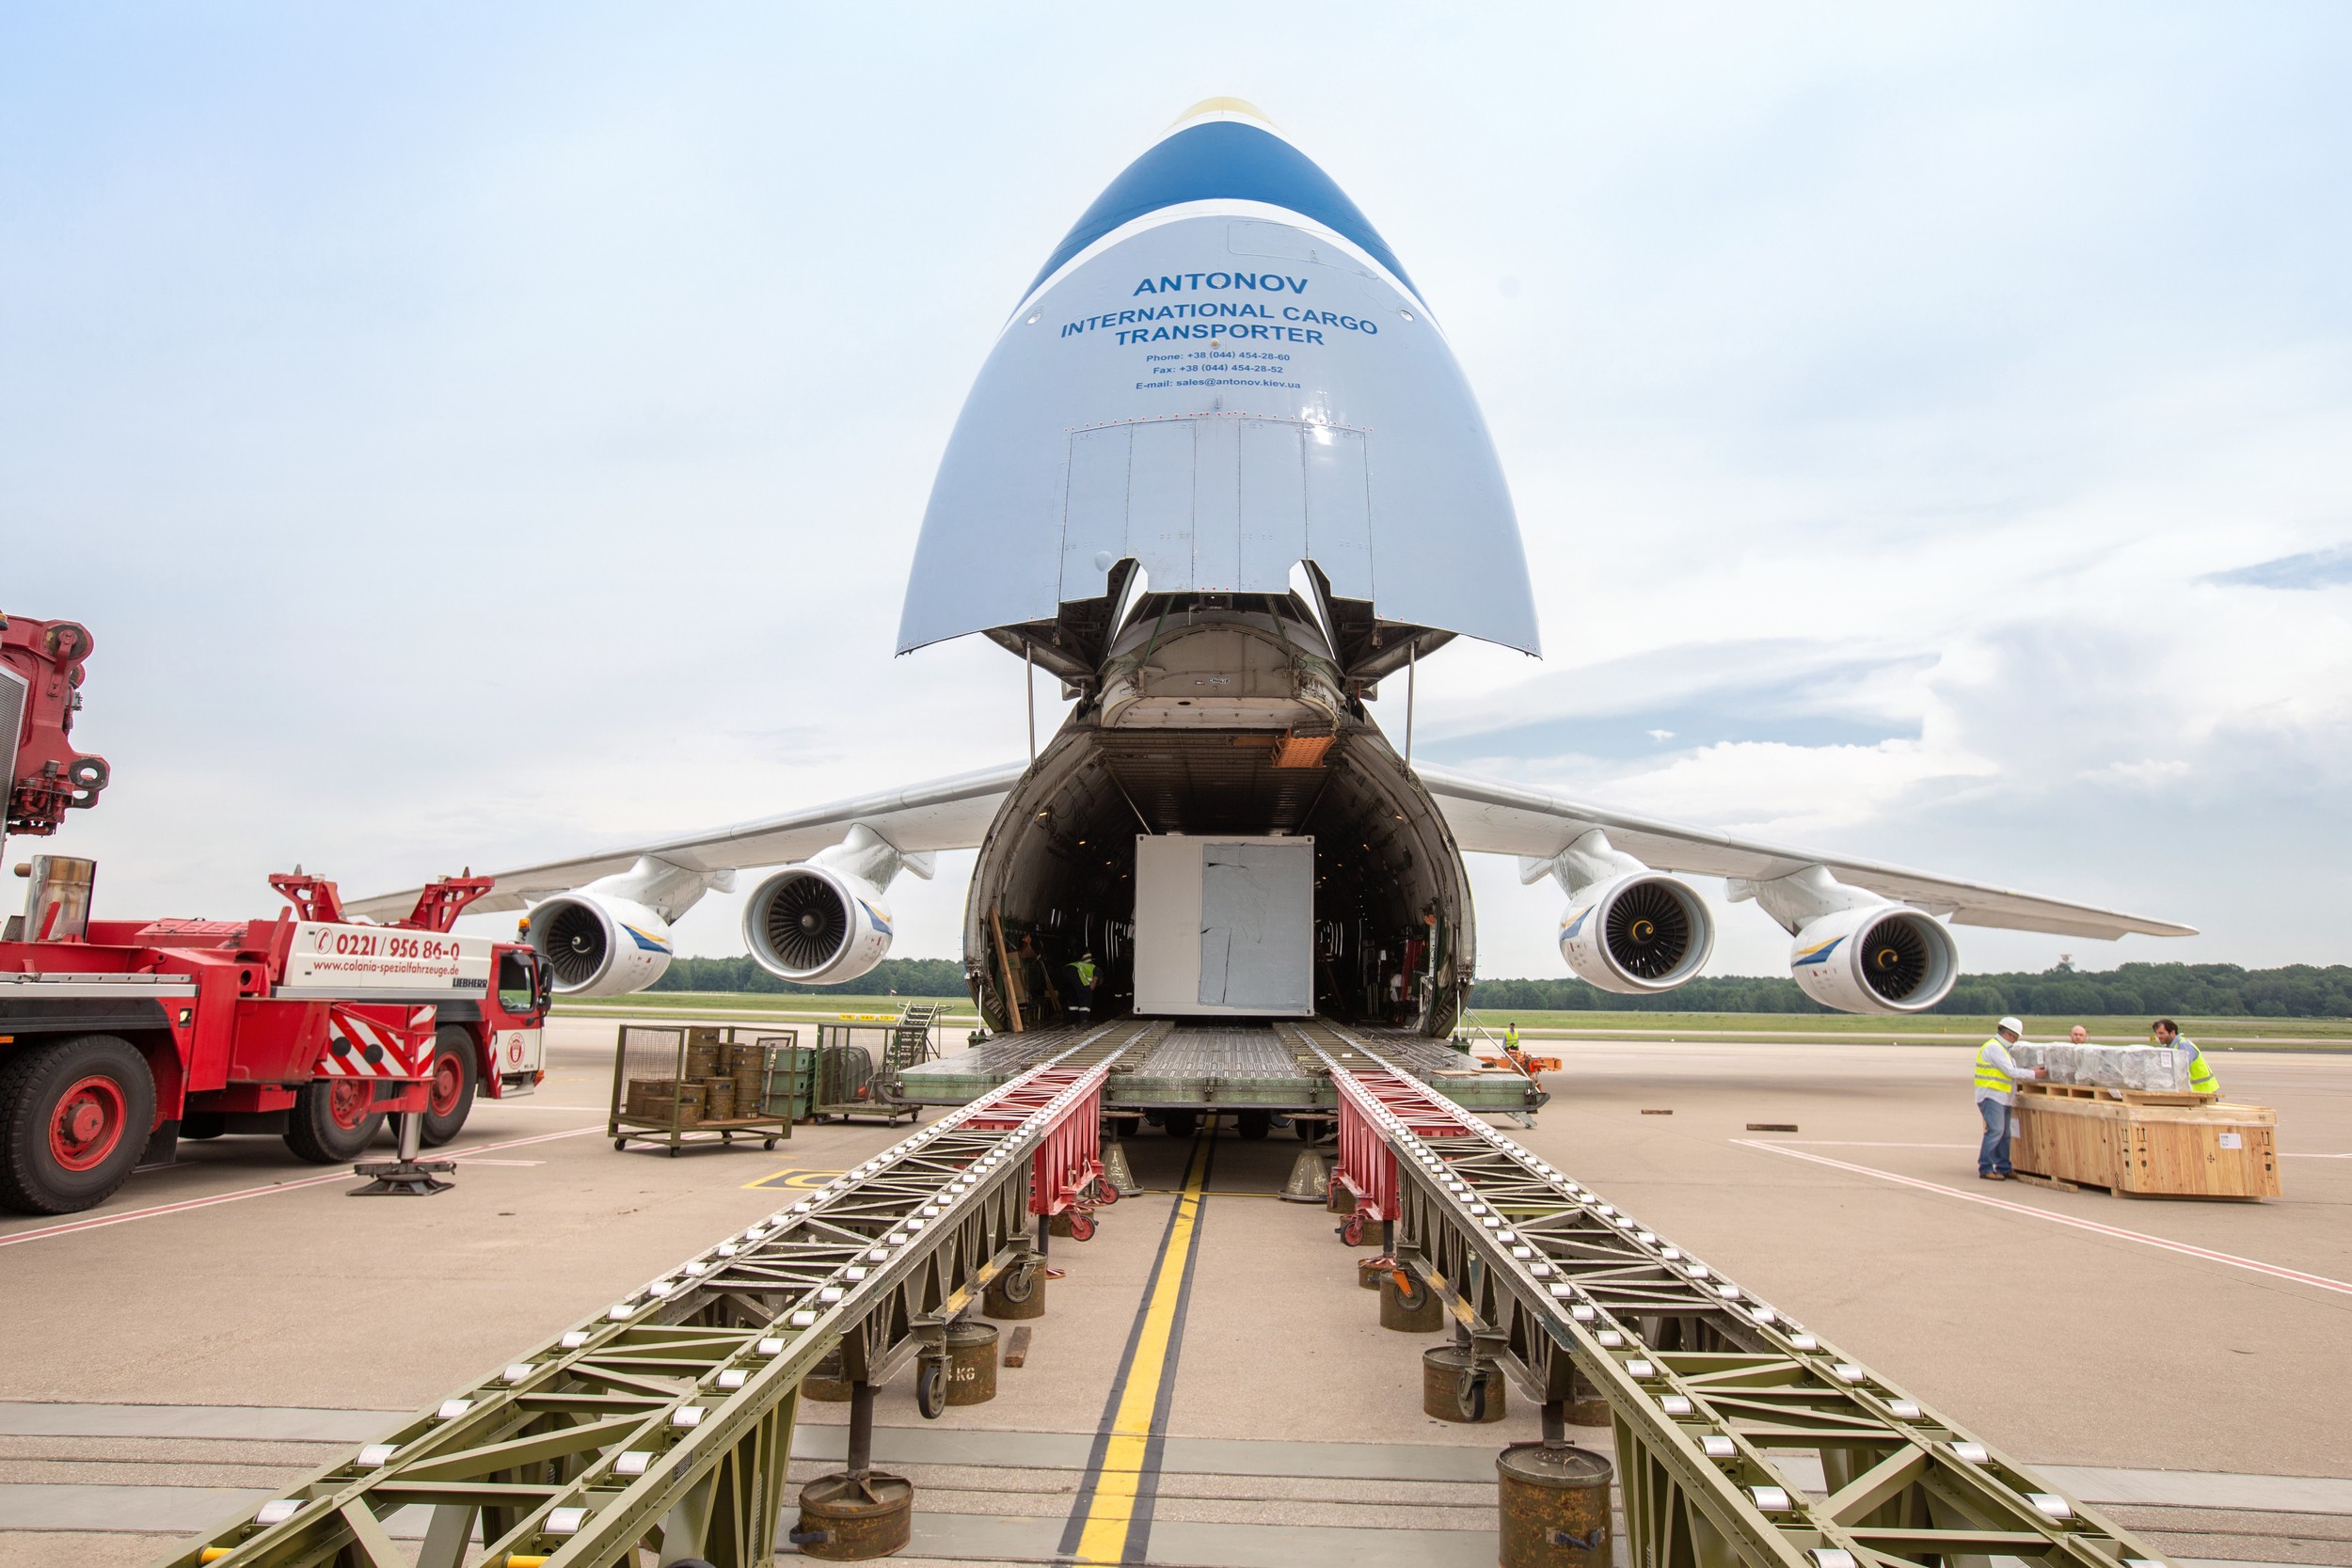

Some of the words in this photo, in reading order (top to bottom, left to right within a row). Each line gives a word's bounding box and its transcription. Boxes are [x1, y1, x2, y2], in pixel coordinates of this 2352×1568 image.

[1132, 272, 1309, 296] ANTONOV
[1061, 303, 1275, 339] INTERNATIONAL
[1282, 306, 1379, 335] CARGO
[1115, 324, 1325, 346] TRANSPORTER
[1146, 353, 1184, 362] Phone:
[1209, 351, 1236, 359] (044)
[1239, 352, 1291, 361] 454-28-60
[1152, 366, 1176, 374] Fax:
[1201, 364, 1228, 372] (044)
[1232, 364, 1283, 373] 454-28-52
[1136, 380, 1173, 389] E-mail:
[1176, 377, 1301, 389] sales@antonov.kiev.ua
[336, 933, 377, 956] 0221
[389, 937, 419, 958] 956
[422, 940, 460, 960] 86-0
[313, 959, 459, 977] www.colonia-spezialfahrzeuge.de
[453, 977, 487, 989] LIEBHERR
